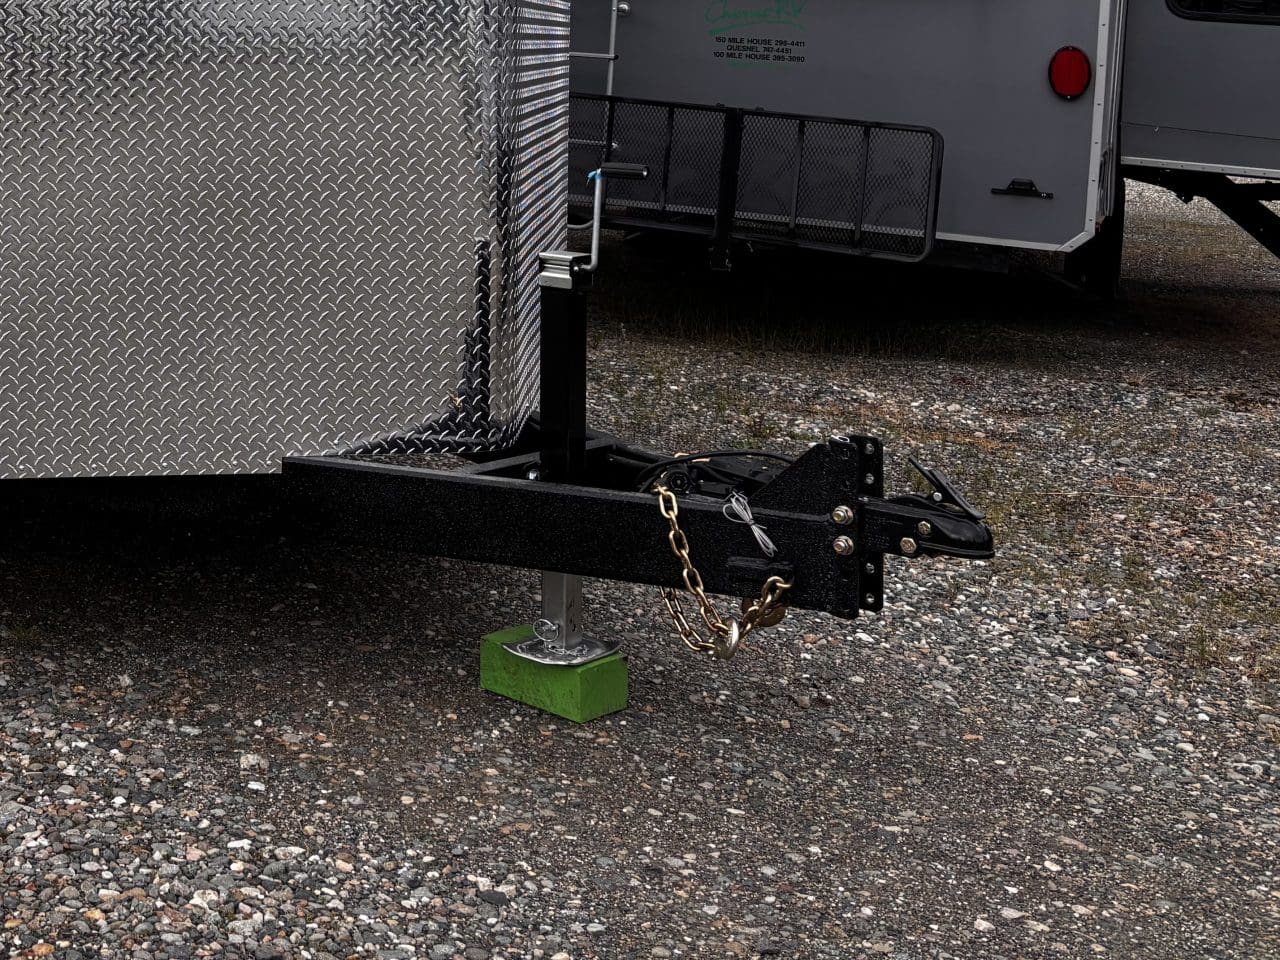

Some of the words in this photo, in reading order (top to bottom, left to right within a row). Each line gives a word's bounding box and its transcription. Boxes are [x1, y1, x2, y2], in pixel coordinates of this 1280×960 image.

[715, 36, 727, 44] 150
[728, 37, 745, 45] MILE
[747, 38, 773, 46] HOUSE
[726, 44, 761, 53] QUESNEL
[726, 52, 743, 60] MILE
[745, 52, 771, 61] HOUSE
